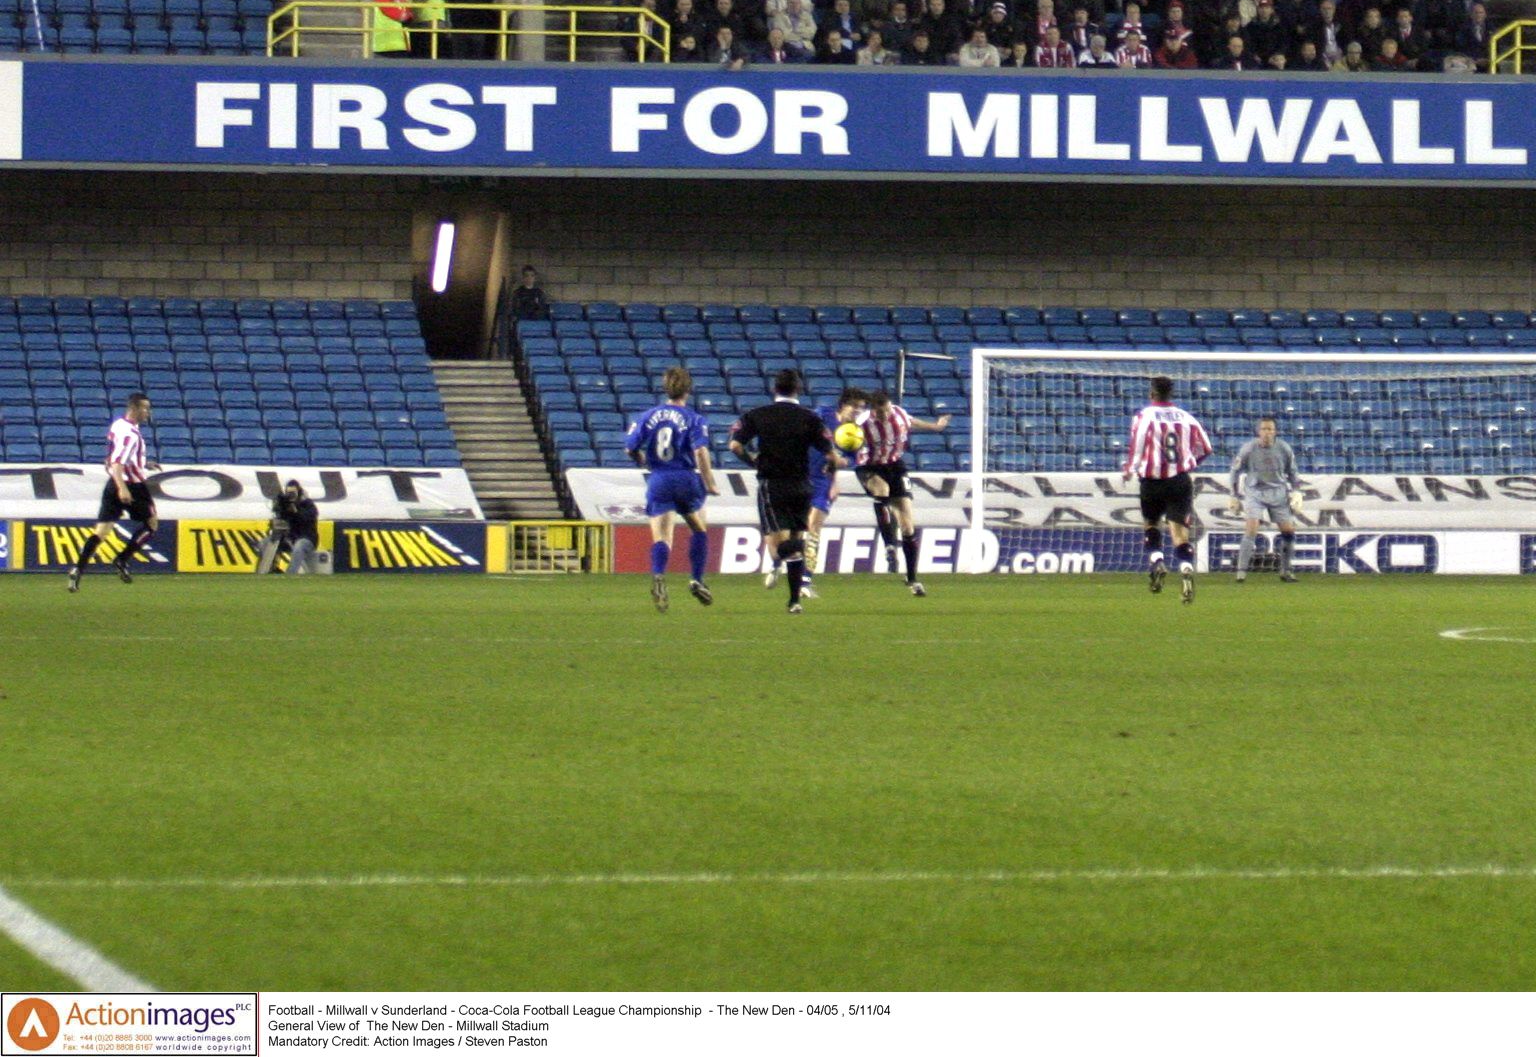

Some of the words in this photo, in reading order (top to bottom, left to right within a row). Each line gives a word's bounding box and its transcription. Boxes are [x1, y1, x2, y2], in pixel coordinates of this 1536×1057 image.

[195, 82, 557, 152] FIRST
[610, 86, 850, 156] FOR
[927, 91, 1529, 165] MILLWALL
[656, 427, 675, 462] 8
[1165, 432, 1179, 464] 8
[144, 469, 441, 503] OUT
[343, 525, 480, 569] THINK!
[1208, 533, 1440, 575] BEKO
